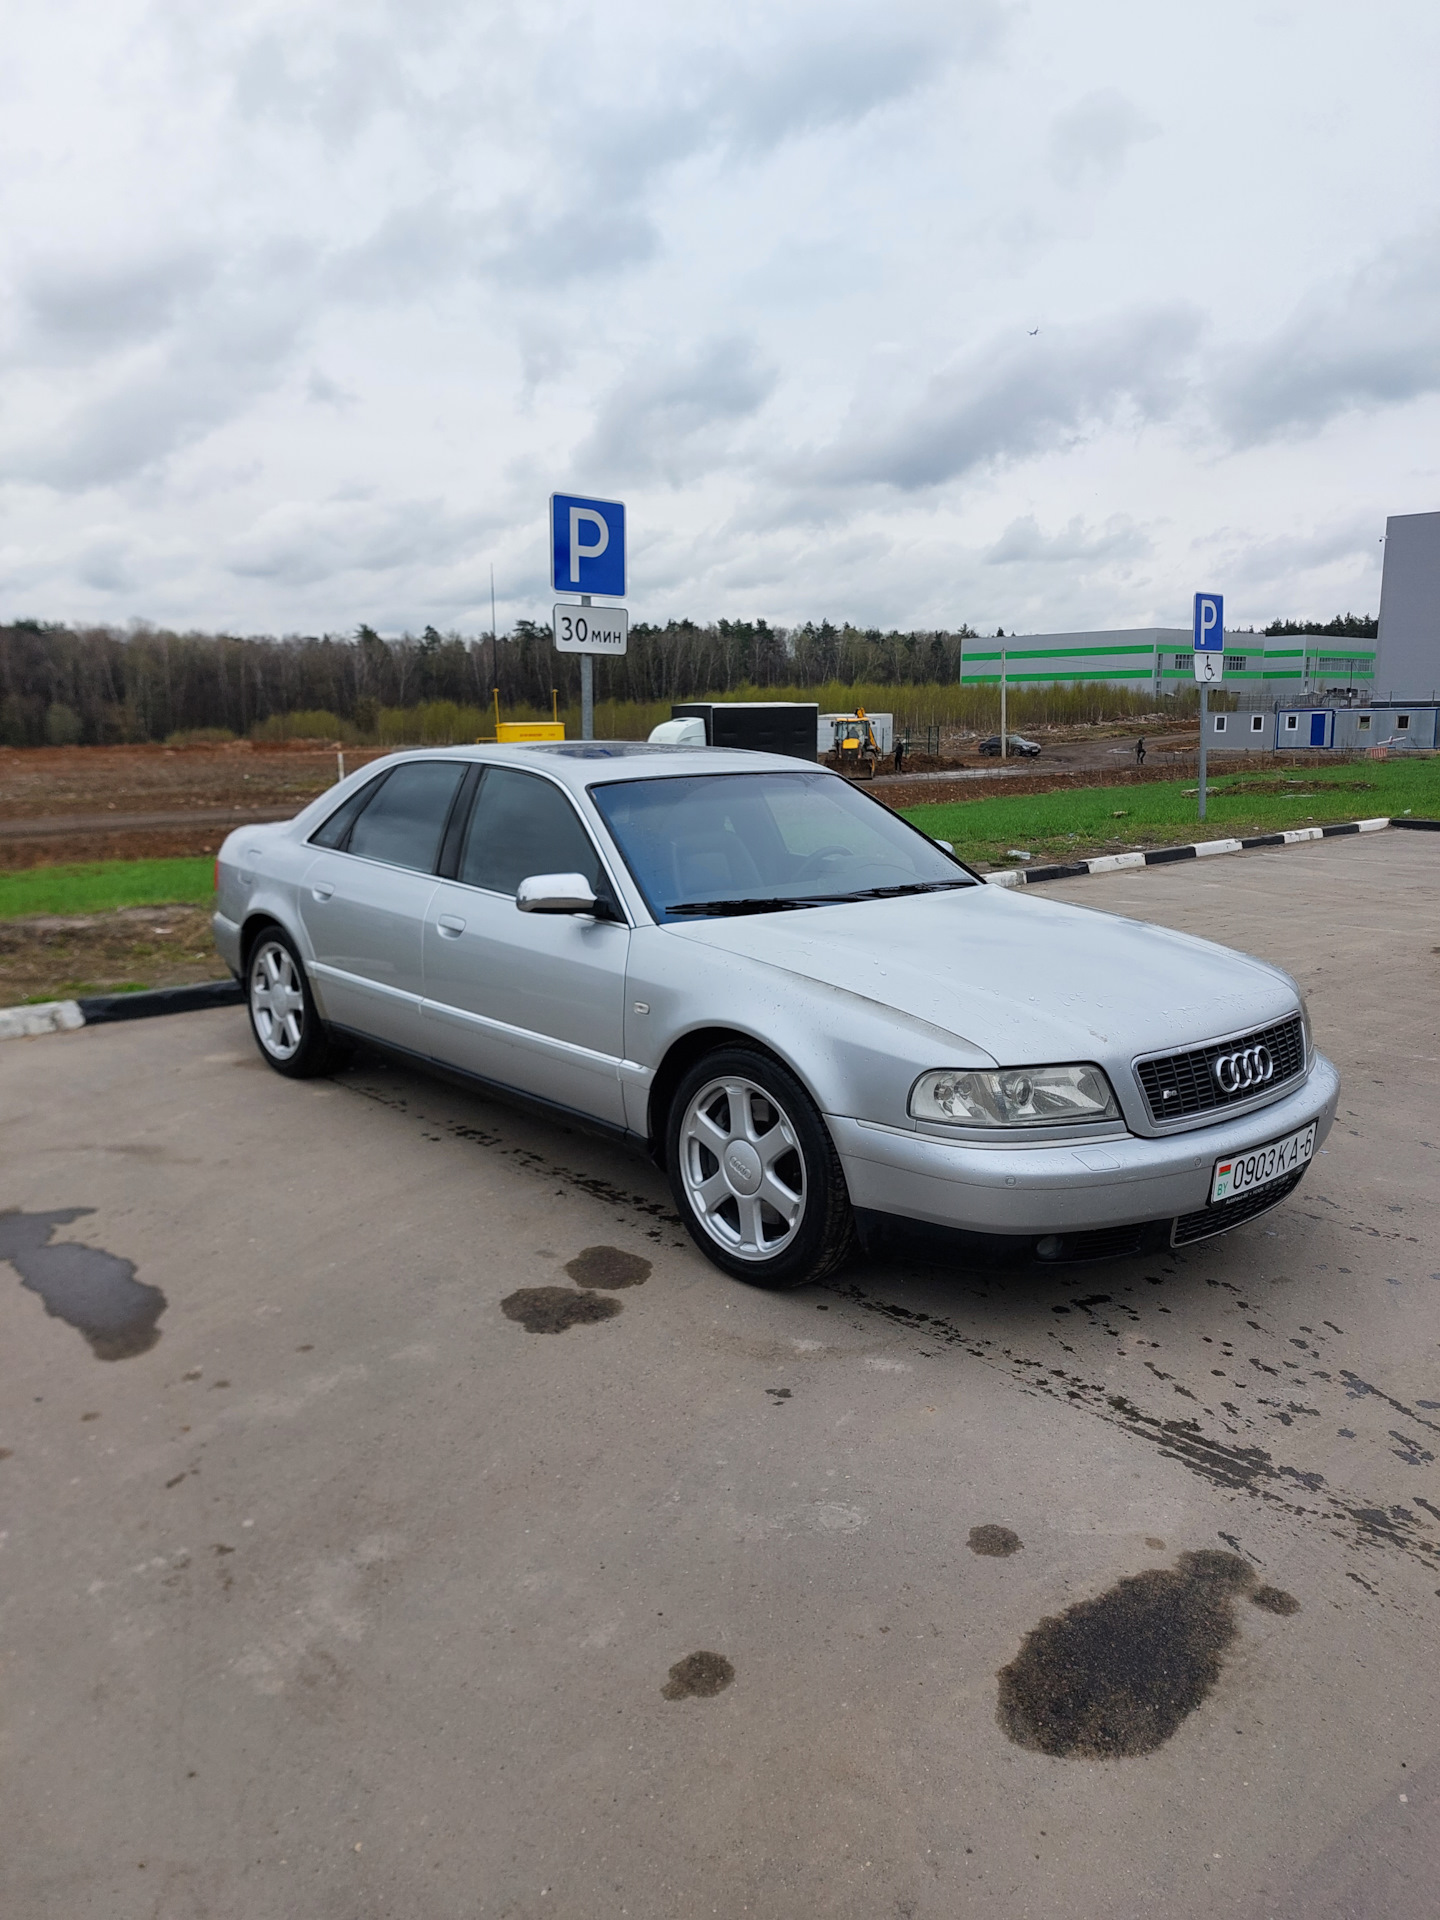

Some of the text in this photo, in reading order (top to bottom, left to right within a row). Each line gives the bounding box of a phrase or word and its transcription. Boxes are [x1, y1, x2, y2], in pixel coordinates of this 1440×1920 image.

[569, 506, 610, 583] P
[561, 617, 588, 642] 30
[1200, 599, 1217, 645] P
[1216, 1181, 1229, 1196] BY
